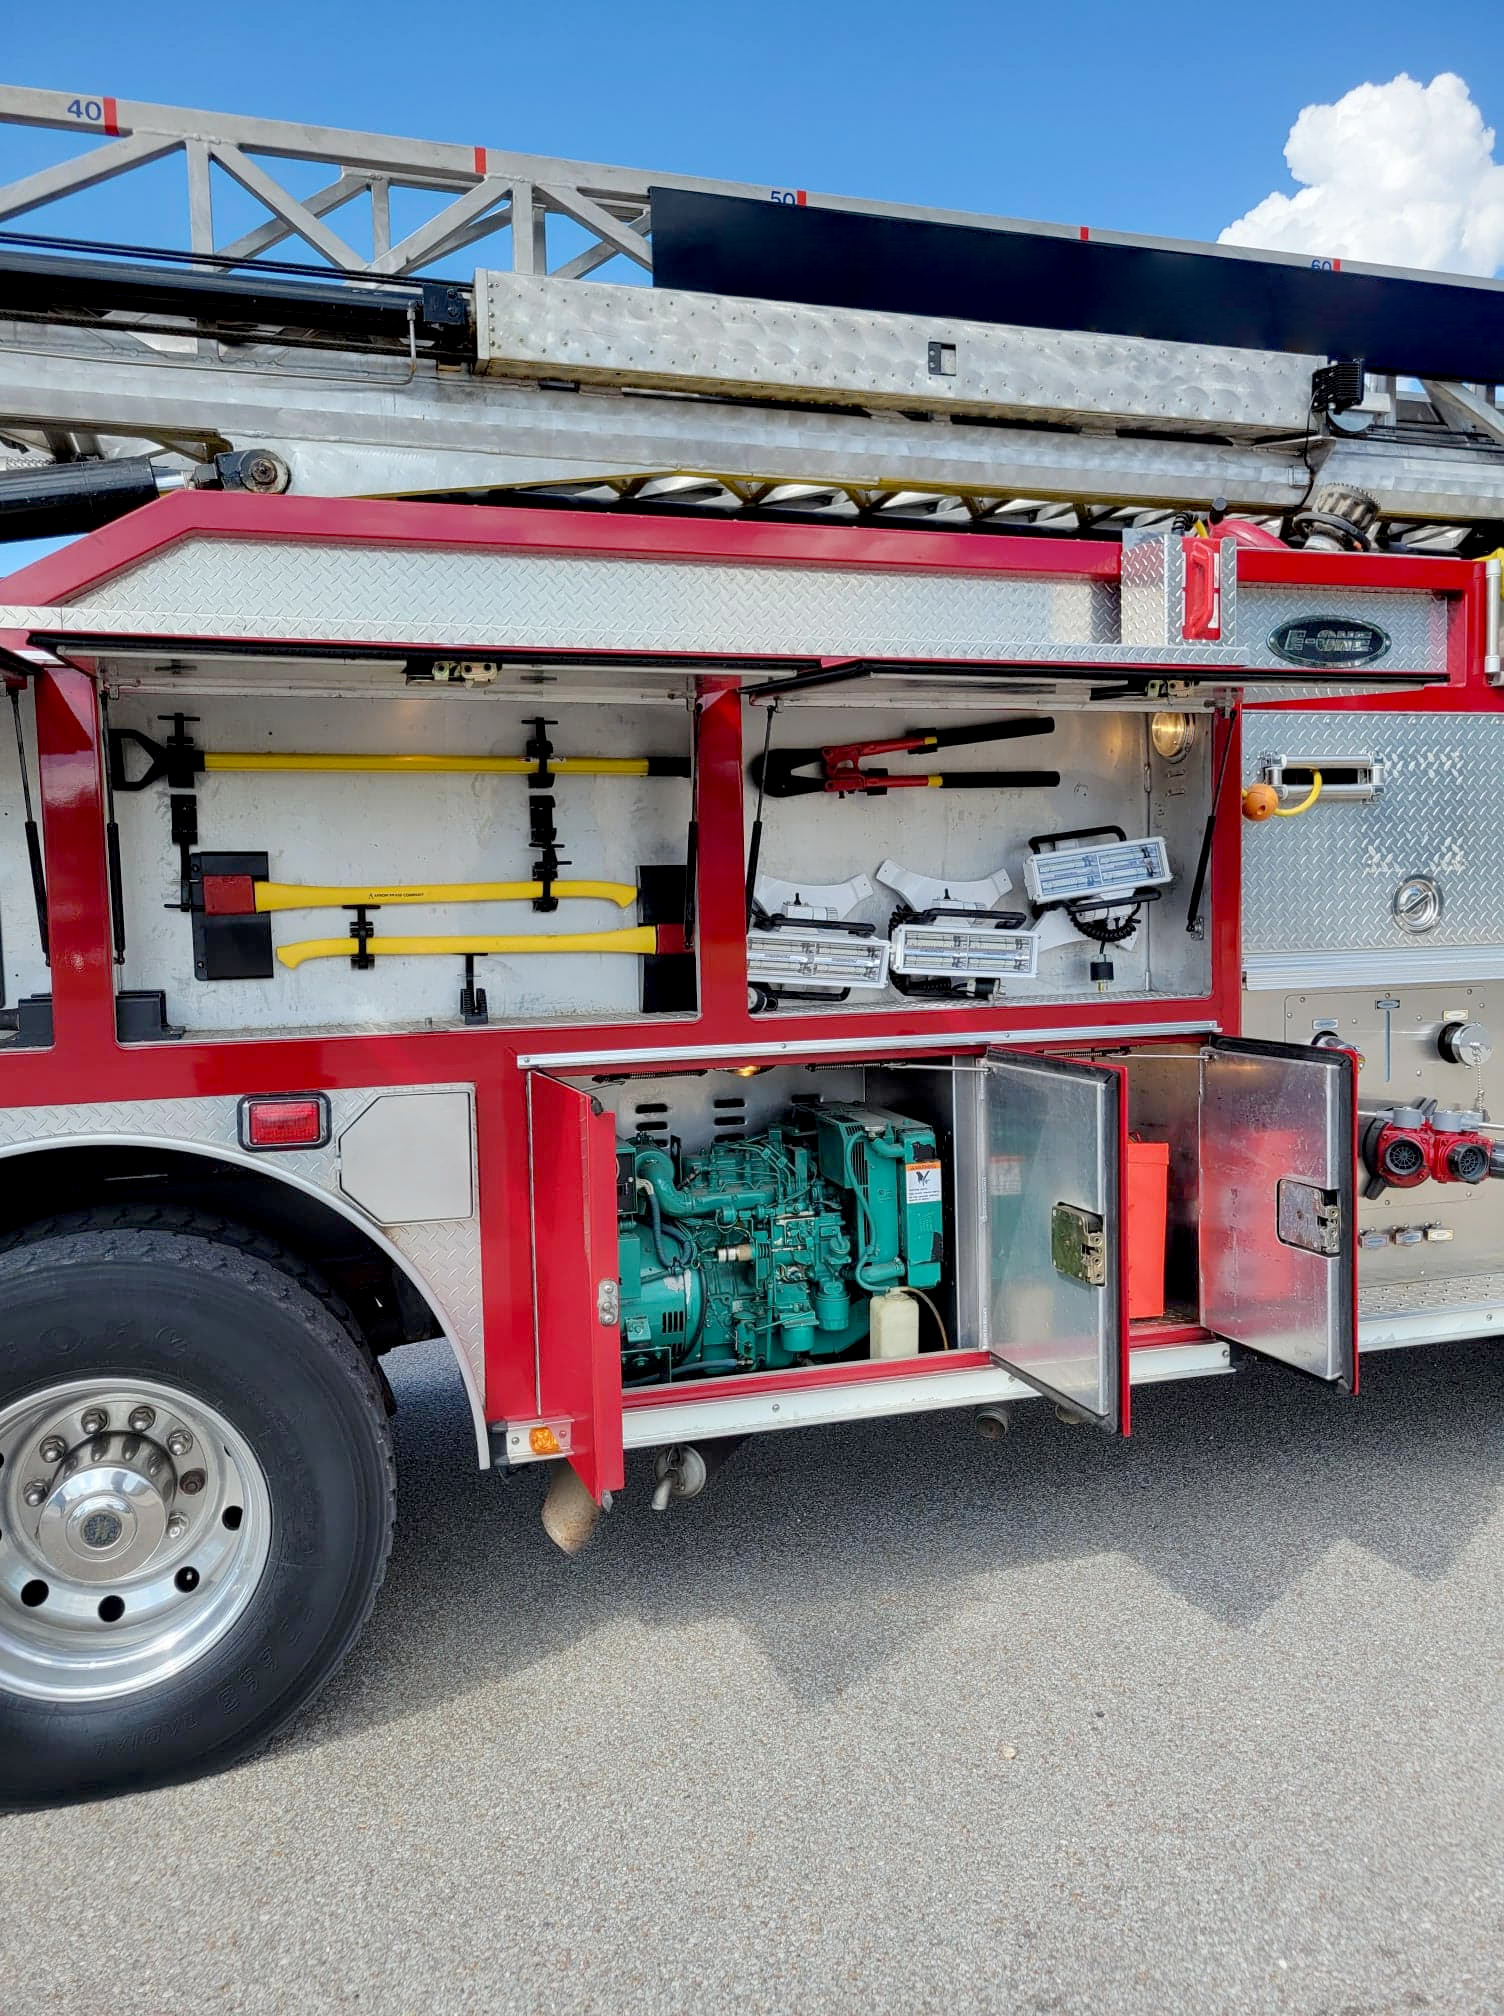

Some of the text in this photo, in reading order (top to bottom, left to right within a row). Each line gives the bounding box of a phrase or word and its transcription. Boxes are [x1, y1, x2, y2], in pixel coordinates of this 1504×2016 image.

[67, 99, 102, 121] 40
[770, 190, 796, 205] 50
[1283, 629, 1373, 652] E-ONE
